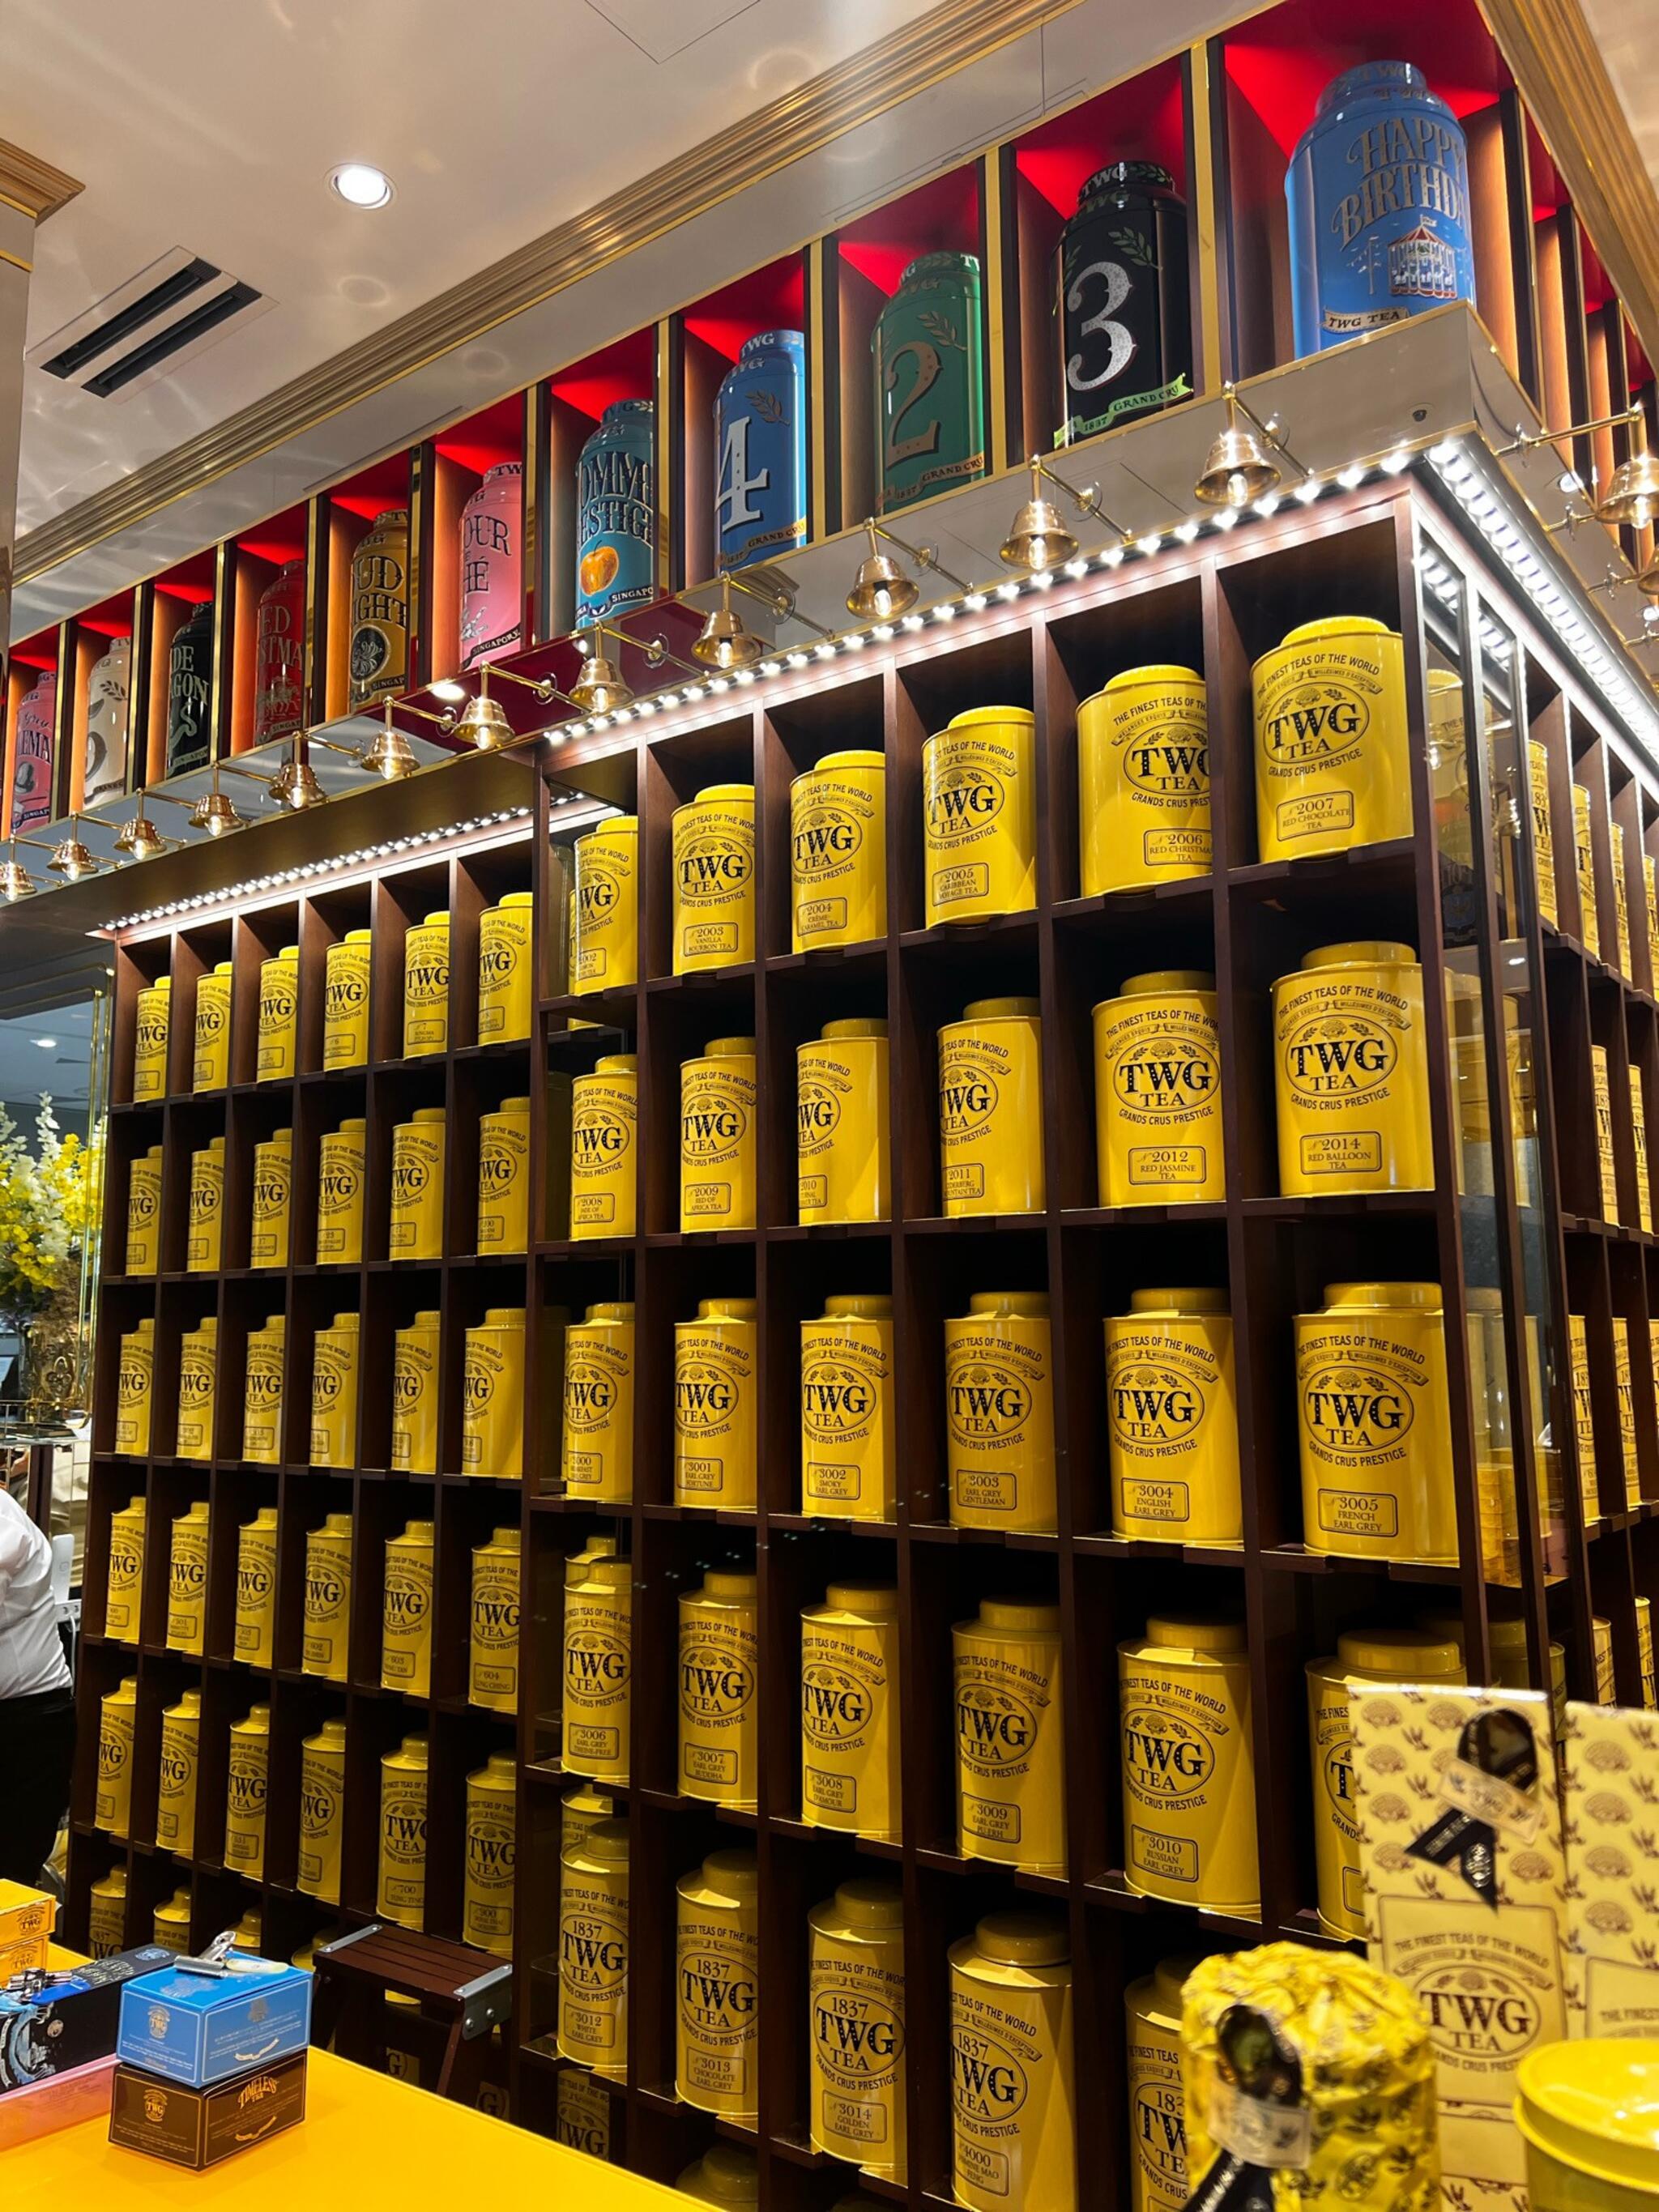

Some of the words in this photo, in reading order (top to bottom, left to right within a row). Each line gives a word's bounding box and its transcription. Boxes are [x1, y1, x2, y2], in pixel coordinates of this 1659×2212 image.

[1082, 166, 1128, 196] TWG
[1067, 261, 1137, 392] 3
[1328, 317, 1362, 328] TWG
[1367, 310, 1401, 324] TEA
[740, 333, 775, 358] TWG
[885, 341, 944, 471] 2
[1113, 393, 1157, 411] GRAND
[1158, 385, 1179, 401] CRU
[715, 416, 769, 533] 4
[921, 462, 962, 482] GRAND
[963, 457, 984, 471] CRU
[748, 531, 784, 548] GRAND
[1266, 664, 1289, 685] FINEST
[1290, 655, 1311, 670] TEAS
[1314, 654, 1325, 663] OF
[1328, 654, 1347, 664] THE
[1349, 655, 1380, 676] WORLD
[1114, 712, 1130, 726] THE
[1130, 700, 1158, 716] FINEST
[1162, 697, 1183, 707] TEAS
[1185, 698, 1195, 706] OF
[1268, 703, 1361, 750] TWG
[1286, 738, 1332, 759] TEA
[1269, 766, 1292, 778] GRANDS
[1294, 763, 1316, 776] CRUS
[1319, 748, 1363, 771] PRESTIGE
[1156, 777, 1201, 791] TEA
[928, 785, 996, 825] TWG
[1132, 792, 1164, 807] GRANDS
[1166, 798, 1188, 808] CRUS
[1296, 799, 1333, 815] 2007
[939, 816, 971, 834] TEA
[1283, 818, 1296, 827] RED
[1298, 809, 1350, 823] CHOCOLATE
[1307, 821, 1322, 829] TEA
[794, 825, 855, 861] TWG
[1168, 833, 1202, 845] 2006
[1149, 846, 1167, 855] RED
[1178, 854, 1192, 862] TEA
[680, 854, 746, 884] TWG
[803, 854, 833, 870] TEA
[945, 868, 974, 881] 2005
[692, 880, 724, 893] TEA
[807, 902, 832, 914] 2004
[407, 965, 450, 989] TWG
[413, 986, 435, 996] TEA
[1278, 1003, 1289, 1020] THE
[1290, 991, 1312, 1011] FINEST
[1315, 987, 1337, 999] TEAS
[1340, 986, 1352, 995] OF
[1354, 986, 1373, 998] THE
[1376, 991, 1408, 1011] WORLD
[1290, 1038, 1388, 1078] TWG
[1120, 1060, 1213, 1094] TWG
[1310, 1074, 1358, 1091] TEA
[1140, 1092, 1188, 1106] TEA
[1290, 1093, 1317, 1110] GRANDS
[1320, 1098, 1342, 1110] CRUS
[1346, 1087, 1390, 1108] PRESTIGE
[1119, 1109, 1147, 1124] GRANDS
[1149, 1115, 1171, 1125] CRUS
[1174, 1106, 1214, 1123] PRESTIGE
[682, 1112, 740, 1141] TWG
[572, 1126, 623, 1153] TWG
[690, 1140, 718, 1153] TEA
[1321, 1138, 1362, 1151] 2014
[579, 1152, 603, 1164] TEA
[1152, 1151, 1189, 1163] 2012
[1307, 1153, 1324, 1161] RED
[1326, 1152, 1371, 1161] BALLOON
[1329, 1161, 1347, 1170] TEA
[1141, 1165, 1158, 1173] RED
[1159, 1164, 1197, 1173] JASMINE
[1158, 1173, 1177, 1181] TEA
[694, 1186, 719, 1197] 2009
[1305, 1337, 1328, 1353] FINEST
[1329, 1335, 1351, 1347] TEAS
[1354, 1336, 1367, 1346] OF
[1369, 1337, 1389, 1351] THE
[1392, 1344, 1426, 1365] WORLD
[676, 1383, 731, 1409] TWG
[804, 1383, 869, 1413] TWG
[950, 1386, 1023, 1418] TWG
[1114, 1388, 1196, 1423] TWG
[683, 1410, 710, 1423] TEA
[814, 1413, 845, 1427] TEA
[1308, 1392, 1405, 1430] TWG
[962, 1417, 1000, 1433] TEA
[1128, 1422, 1169, 1438] TEA
[1325, 1428, 1375, 1447] TEA
[1157, 1438, 1197, 1457] PRESTIGE
[1309, 1441, 1334, 1464] GRANDS
[1335, 1455, 1358, 1468] CRUS
[1360, 1447, 1407, 1467] PRESTIGE
[819, 1468, 847, 1480] 3002
[968, 1475, 1000, 1488] 3003
[1139, 1485, 1174, 1498] 3004
[1134, 1506, 1152, 1515] EARL
[1153, 1507, 1175, 1518] GREY
[1137, 1497, 1171, 1508] ENGLISH
[1339, 1497, 1379, 1512] 3005
[1333, 1520, 1354, 1529] EARL
[1356, 1522, 1382, 1532] GREY
[1338, 1511, 1375, 1522] FRENCH
[473, 1601, 520, 1626] TWG
[480, 1626, 505, 1638] TEA
[567, 1649, 625, 1678] TWG
[575, 1677, 605, 1693] TEA
[682, 1664, 748, 1700] TWG
[692, 1694, 723, 1712] TEA
[804, 1681, 866, 1722] TWG
[810, 1715, 842, 1736] TEA
[957, 1702, 1028, 1747] TWG
[967, 1739, 1002, 1760] TEA
[1125, 1728, 1205, 1777] TWG
[1137, 1767, 1177, 1791] TEA
[975, 1804, 1008, 1818] 3009
[1148, 1838, 1182, 1855] 3010
[1146, 1849, 1179, 1865] RUSSIAN
[1143, 1857, 1161, 1870] EARL
[1162, 1863, 1185, 1877] GREY
[573, 1920, 602, 1939] 1837
[562, 1931, 627, 1971] TWG
[571, 1967, 603, 1985] TEA
[695, 1958, 730, 1979] 1837
[682, 1969, 757, 2014] TWG
[693, 2006, 731, 2027] TEA
[831, 1997, 869, 2018] 1837
[1420, 1990, 1531, 2037] TWG
[574, 2014, 602, 2027] 3012
[817, 2006, 898, 2055] TWG
[957, 2031, 989, 2061] 1837
[1453, 2031, 1501, 2053] TEA
[830, 2048, 871, 2071] TEA
[237, 2076, 278, 2109] TIMELESS
[957, 2086, 992, 2117] TEA
[838, 2103, 872, 2120] 3014
